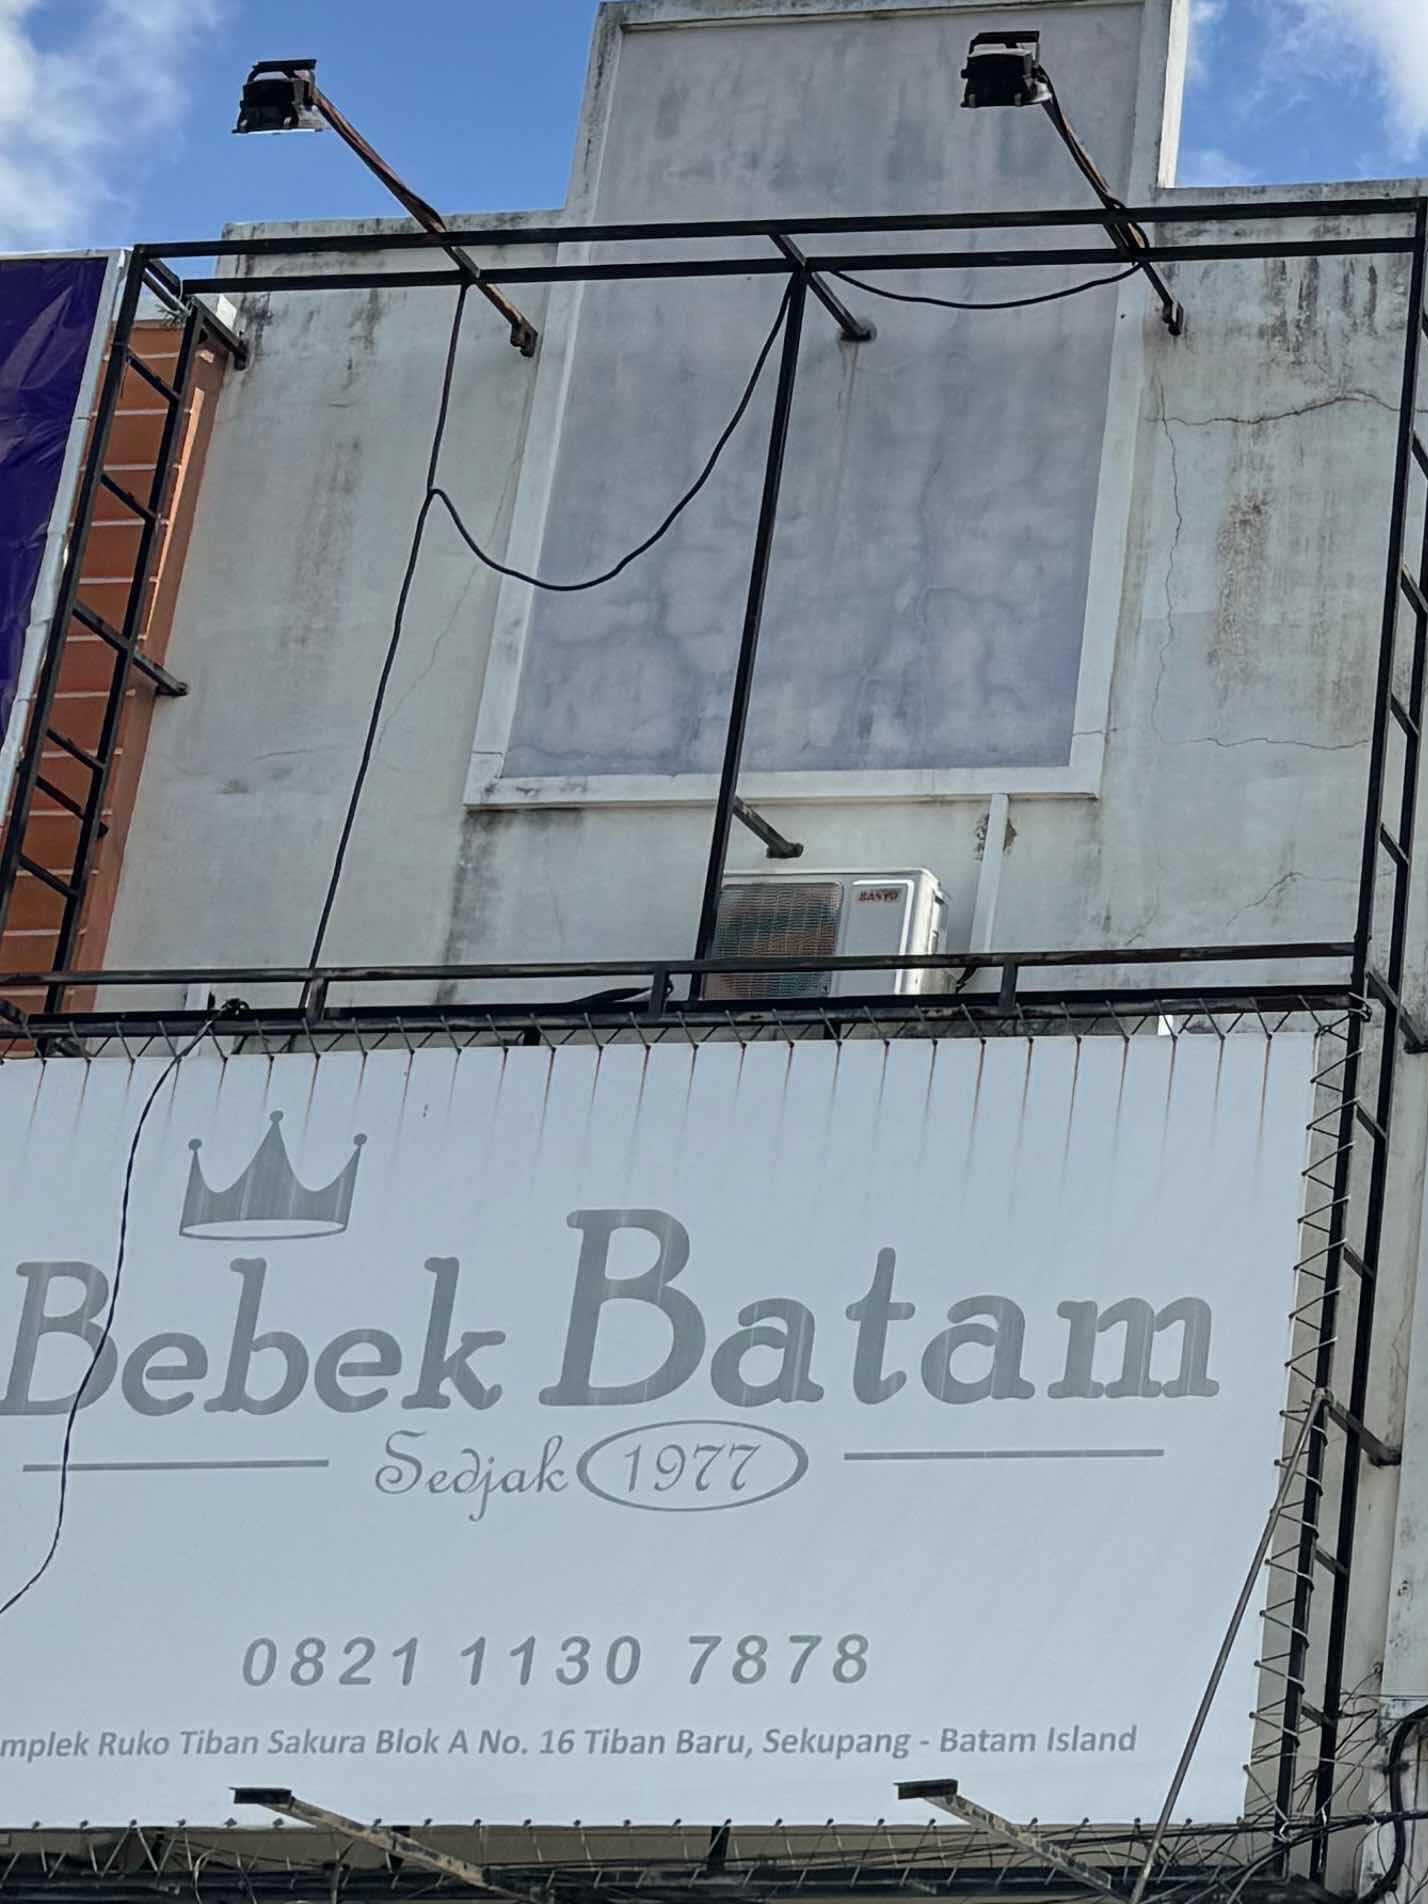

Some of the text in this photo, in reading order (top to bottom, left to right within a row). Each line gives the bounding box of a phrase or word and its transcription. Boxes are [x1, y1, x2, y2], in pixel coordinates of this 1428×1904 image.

[0, 1207, 1220, 1416] Bebek Batam
[375, 1430, 761, 1522] Sedjak 1977
[242, 1634, 870, 1688] 0821 1130 7878
[98, 1730, 171, 1757] Ruko
[180, 1729, 260, 1755] Tiban
[266, 1728, 367, 1756] Sakura
[375, 1728, 441, 1755] Blok
[448, 1729, 470, 1755] A
[477, 1729, 528, 1755] No.
[539, 1729, 576, 1755] 16
[584, 1728, 666, 1755] Tiban
[674, 1728, 753, 1759] Baru,
[762, 1728, 912, 1760] Sekupang
[939, 1727, 1038, 1754] Batam
[1046, 1725, 1138, 1753] Island
